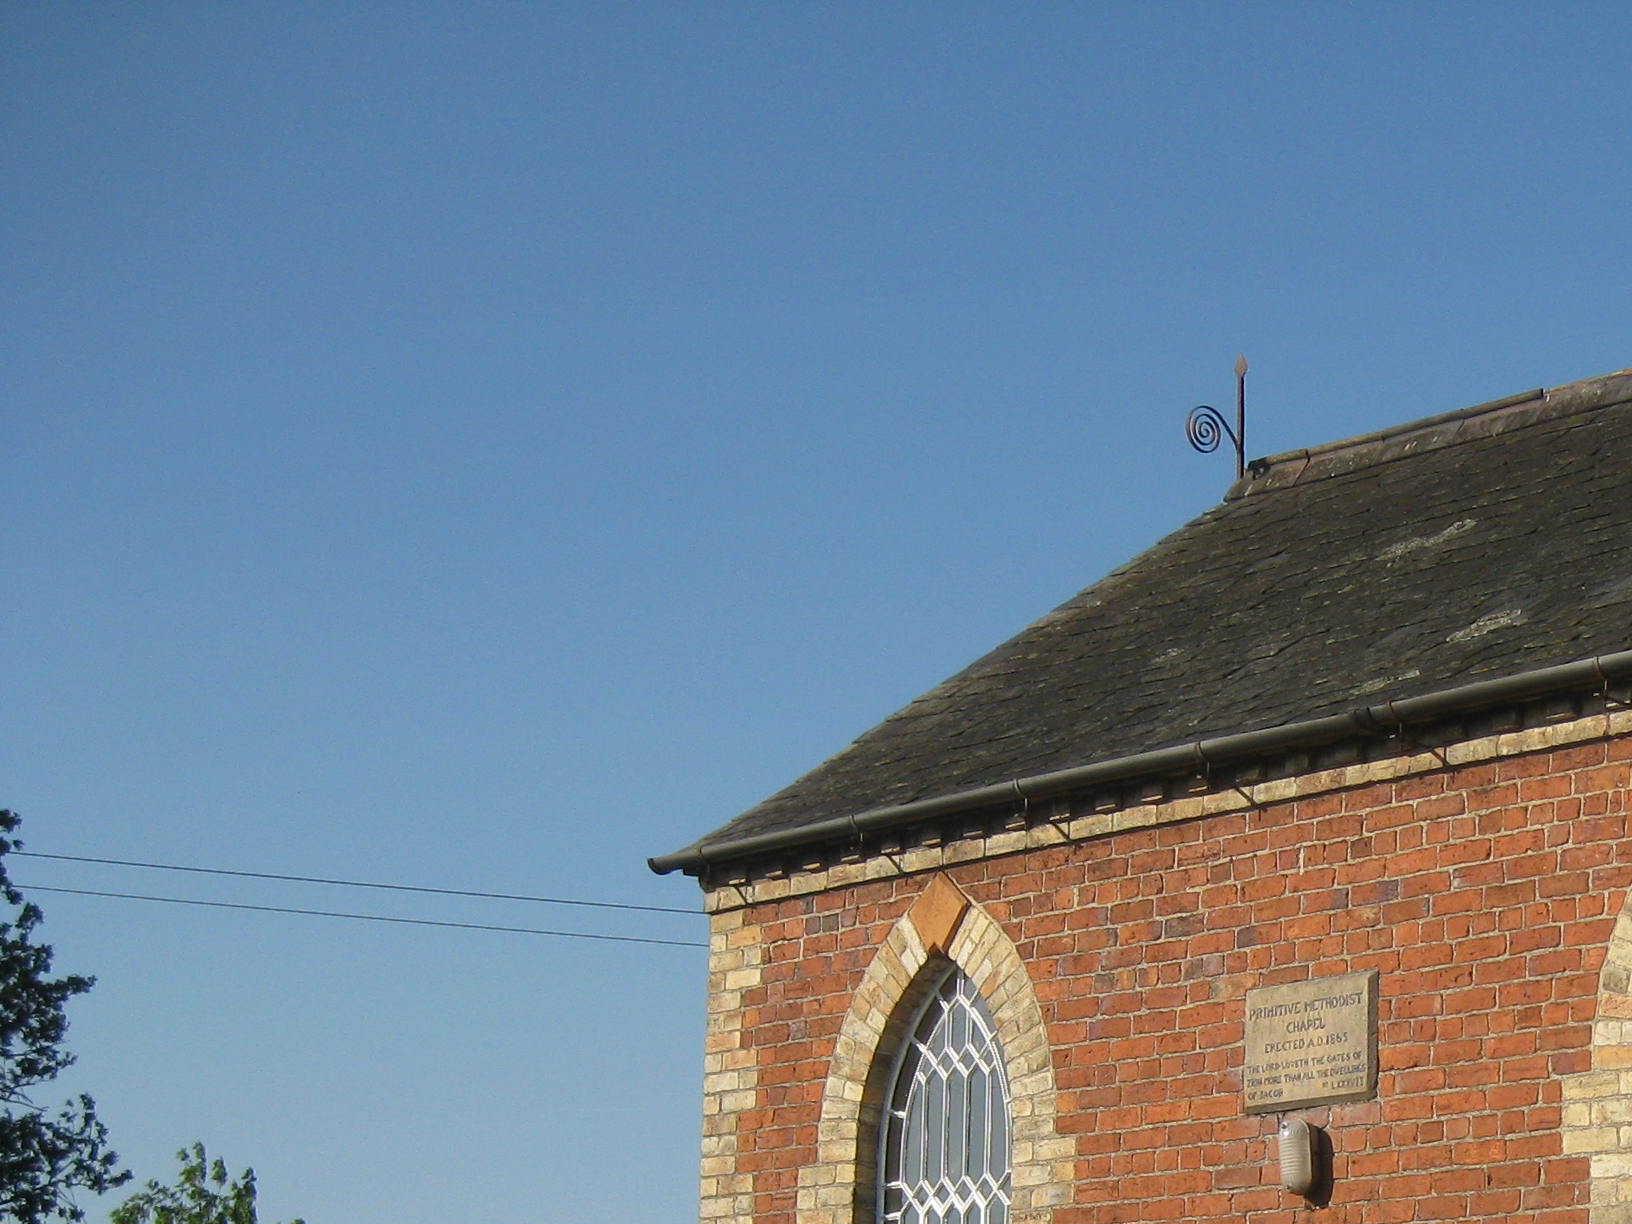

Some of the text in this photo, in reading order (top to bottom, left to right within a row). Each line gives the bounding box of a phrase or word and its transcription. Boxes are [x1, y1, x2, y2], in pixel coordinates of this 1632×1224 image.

[1249, 992, 1363, 1020] PRIMITIVE METHODIST
[1286, 1018, 1325, 1034] CHAPEL
[1264, 1038, 1305, 1054] ERECTED
[1311, 1057, 1324, 1065] THE
[1327, 1053, 1351, 1063] GATES
[1352, 1051, 1362, 1060] OF
[1302, 1071, 1315, 1081] ALL
